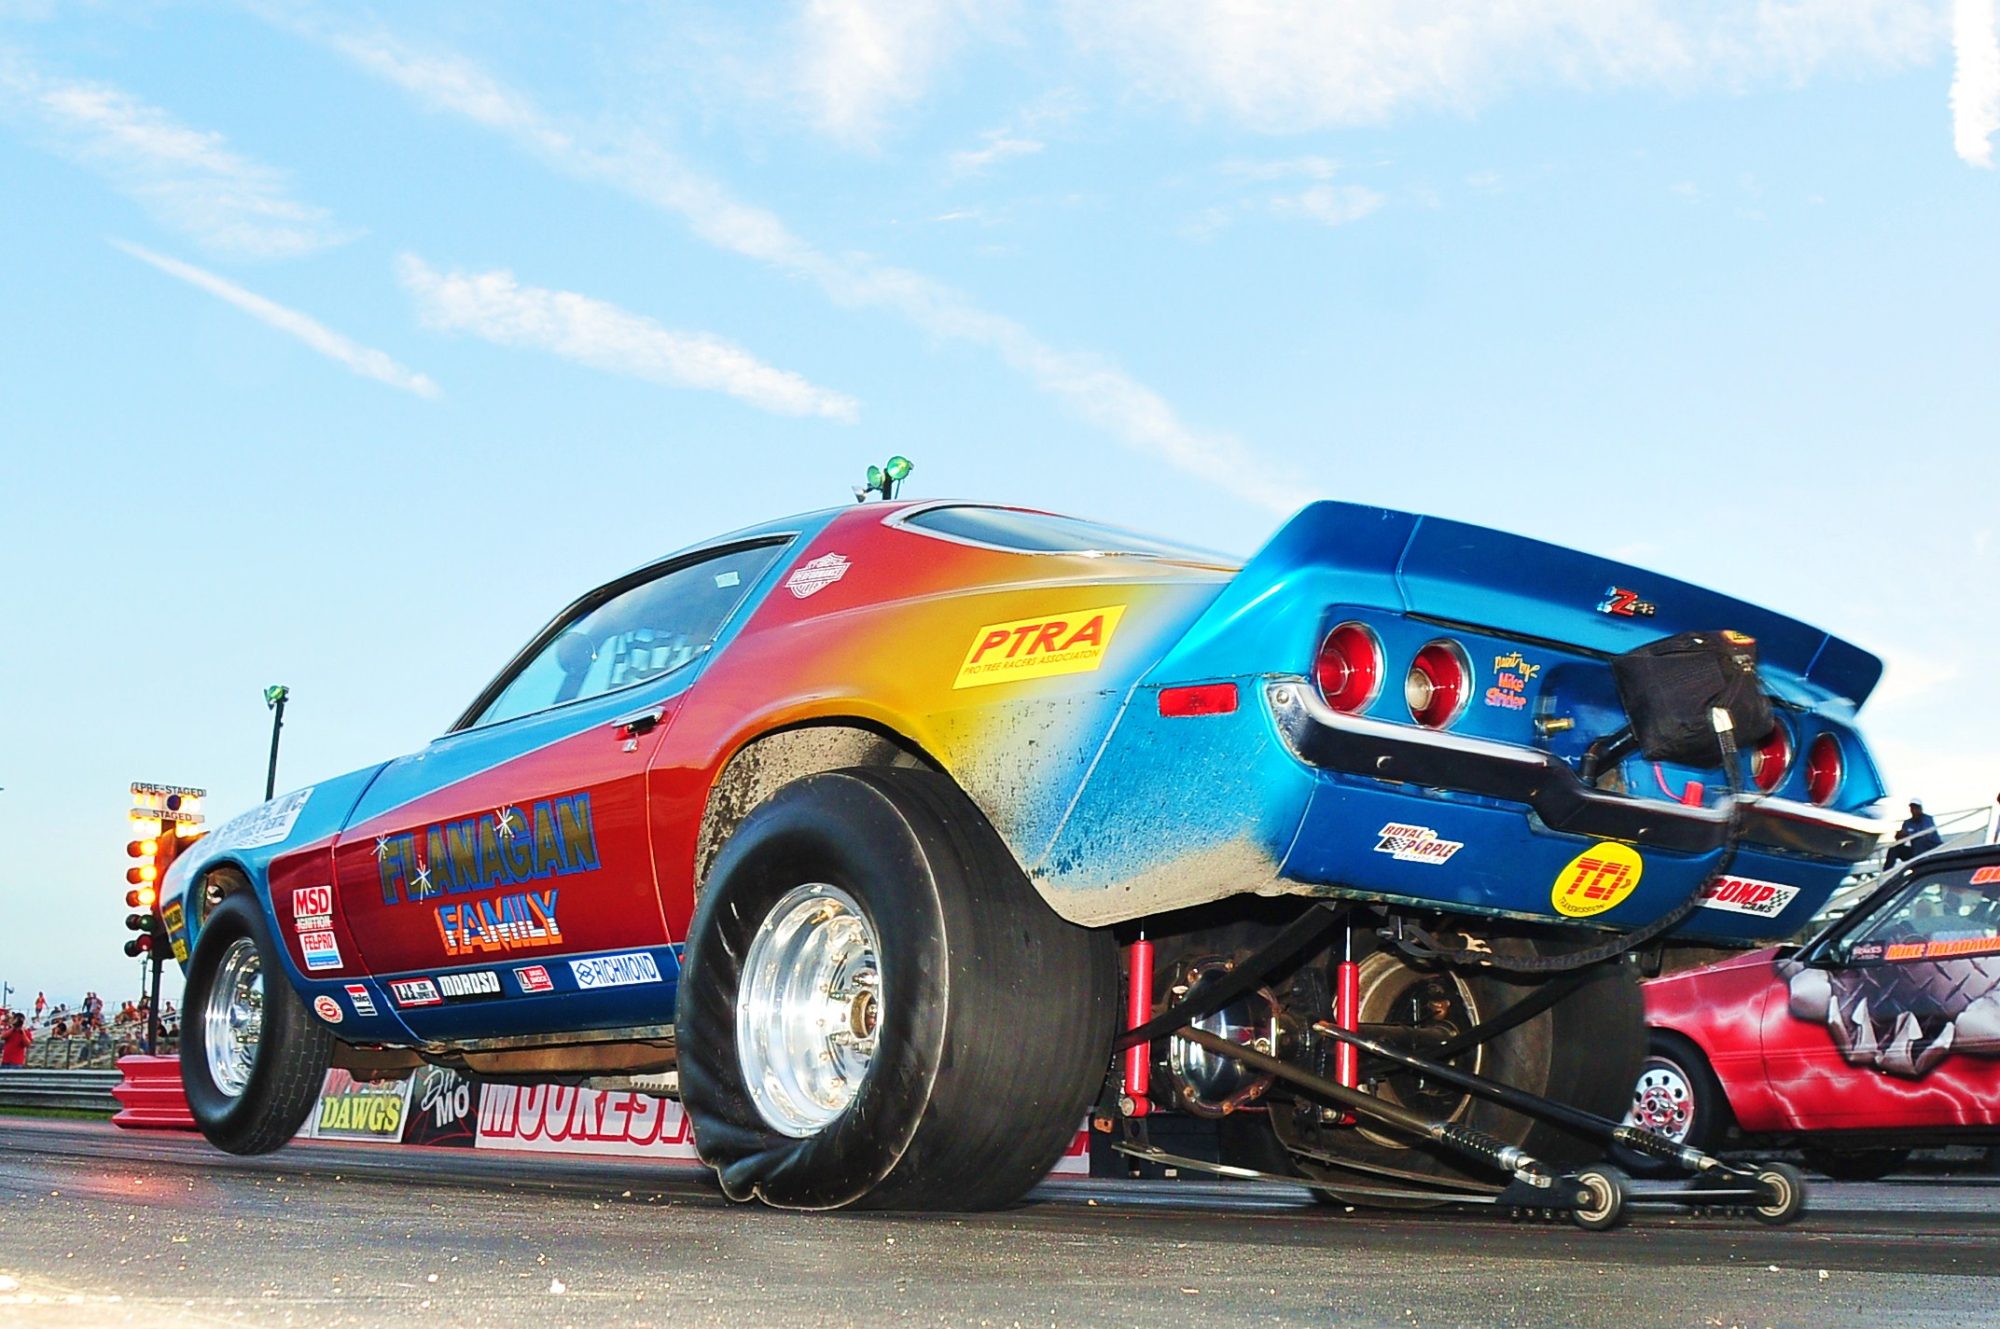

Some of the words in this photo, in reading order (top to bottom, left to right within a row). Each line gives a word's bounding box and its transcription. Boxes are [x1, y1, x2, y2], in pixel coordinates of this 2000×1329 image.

[970, 615, 1104, 664] PTRA
[152, 809, 192, 822] STAGED
[1382, 825, 1425, 839] ROYAL
[379, 791, 601, 905] FLANAGAN
[1401, 839, 1460, 858] PURPLE
[1566, 856, 1632, 901] TCI
[295, 888, 330, 916] MSD
[1741, 902, 1775, 914] CAMS
[434, 888, 563, 956] FAMILY
[437, 970, 501, 997] MOROSO
[593, 955, 657, 984] RICHMOND
[320, 1095, 400, 1132] DAWGS
